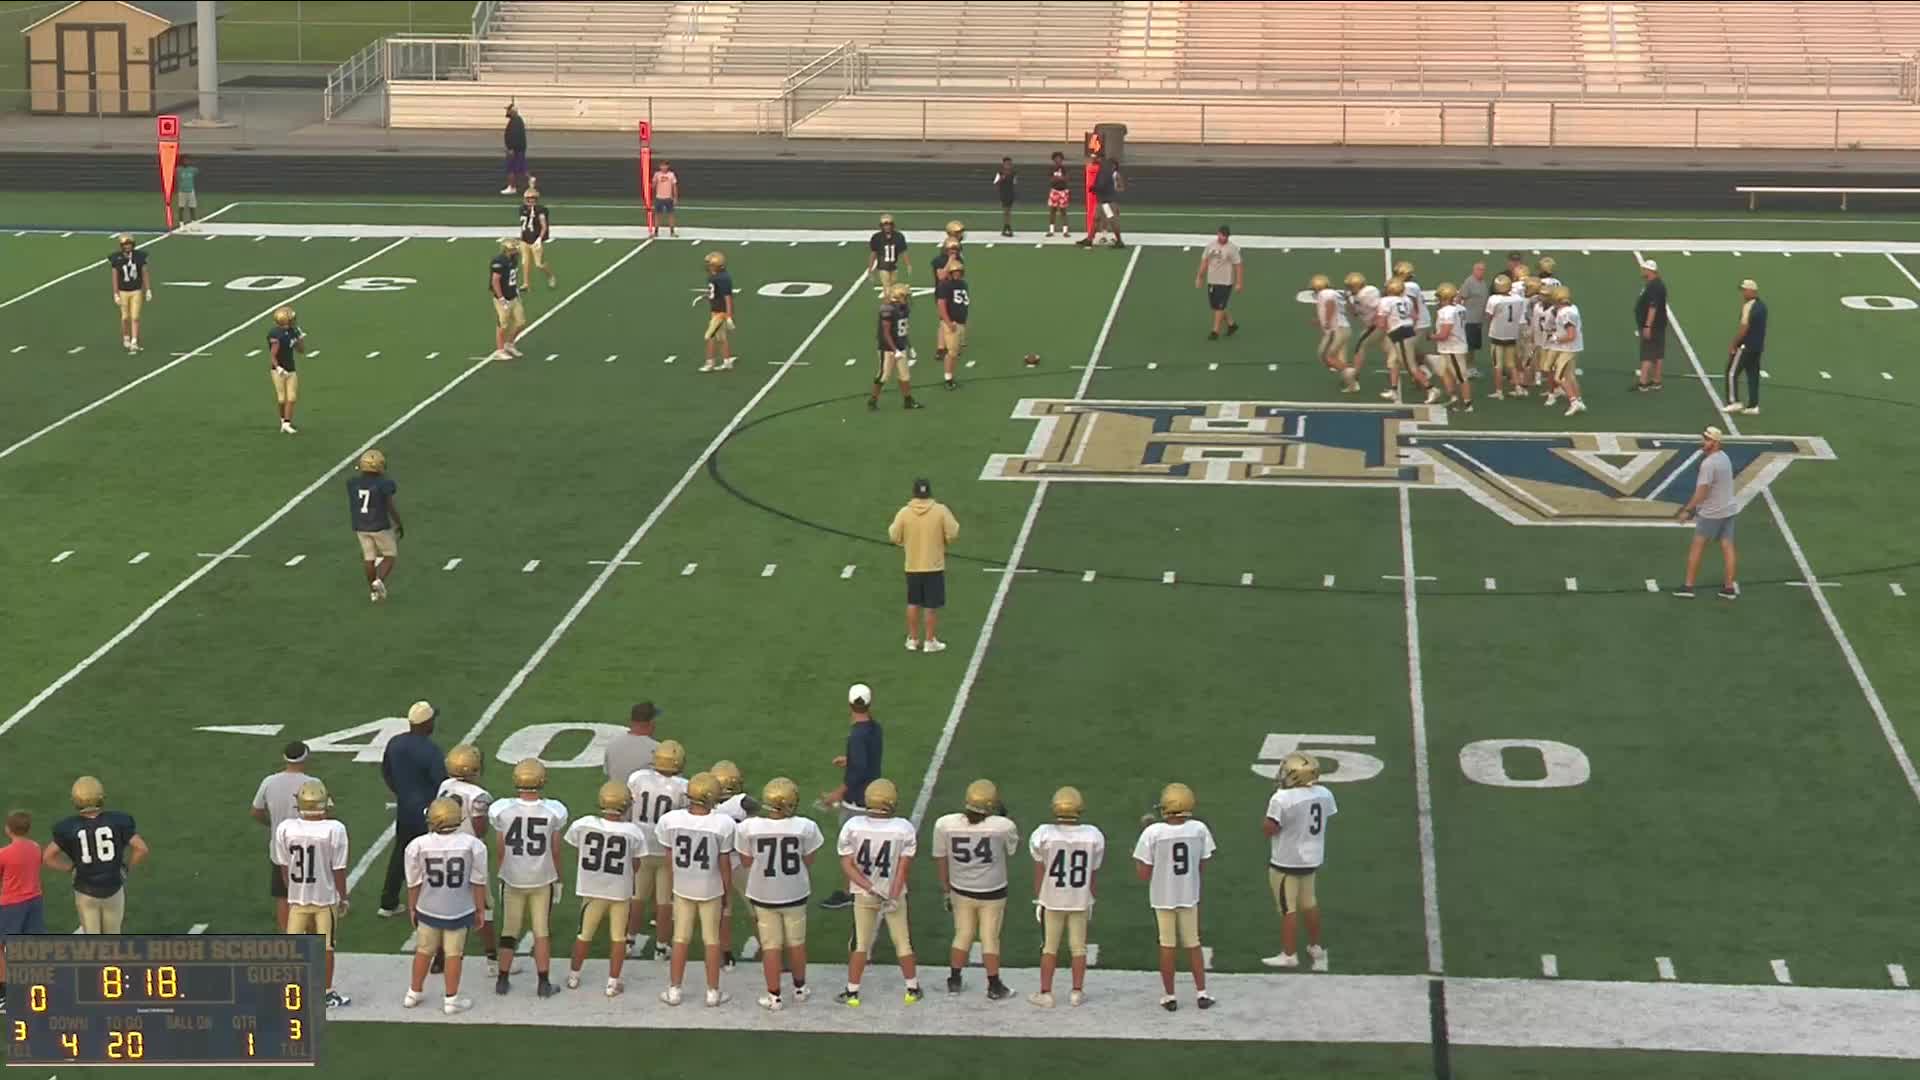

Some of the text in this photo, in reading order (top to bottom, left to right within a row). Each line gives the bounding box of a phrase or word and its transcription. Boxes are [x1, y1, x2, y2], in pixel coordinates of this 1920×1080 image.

[952, 288, 970, 305] 53
[358, 488, 371, 514] 7
[504, 816, 549, 856] 45
[1310, 803, 1323, 836] 3
[77, 826, 115, 864] 16
[581, 832, 628, 875] 32
[675, 835, 711, 870] 34
[756, 837, 801, 877] 76
[856, 838, 892, 878] 44
[951, 837, 993, 865] 54
[1172, 843, 1189, 876] 9
[288, 844, 318, 884] 31
[424, 857, 466, 889] 58
[1048, 849, 1088, 888] 48
